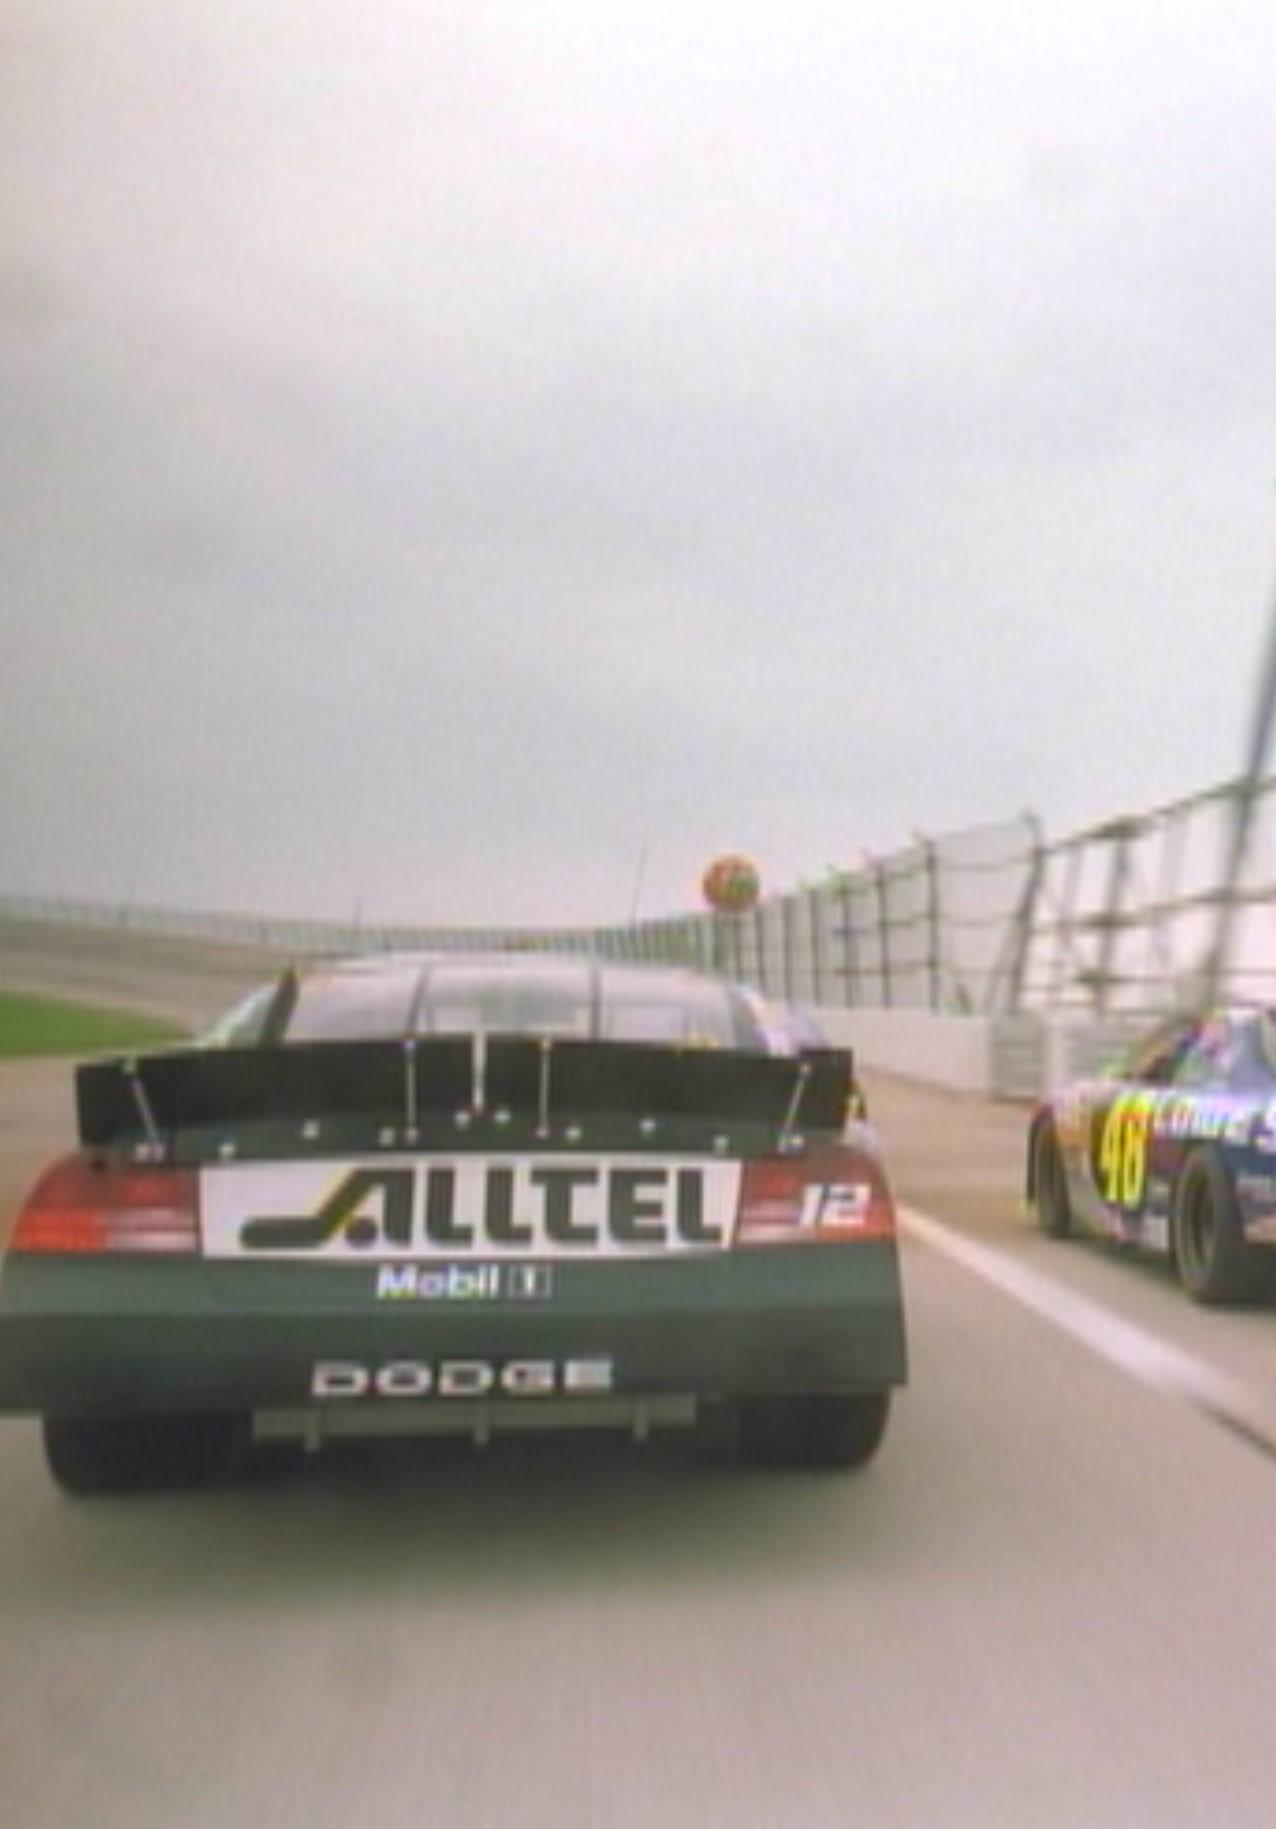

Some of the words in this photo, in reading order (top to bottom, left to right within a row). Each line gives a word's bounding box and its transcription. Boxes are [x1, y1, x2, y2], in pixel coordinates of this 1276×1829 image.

[240, 1166, 724, 1250] ALLTEL
[798, 1182, 868, 1227] 12
[377, 1263, 499, 1300] Mobil
[311, 1358, 614, 1397] DODGE
